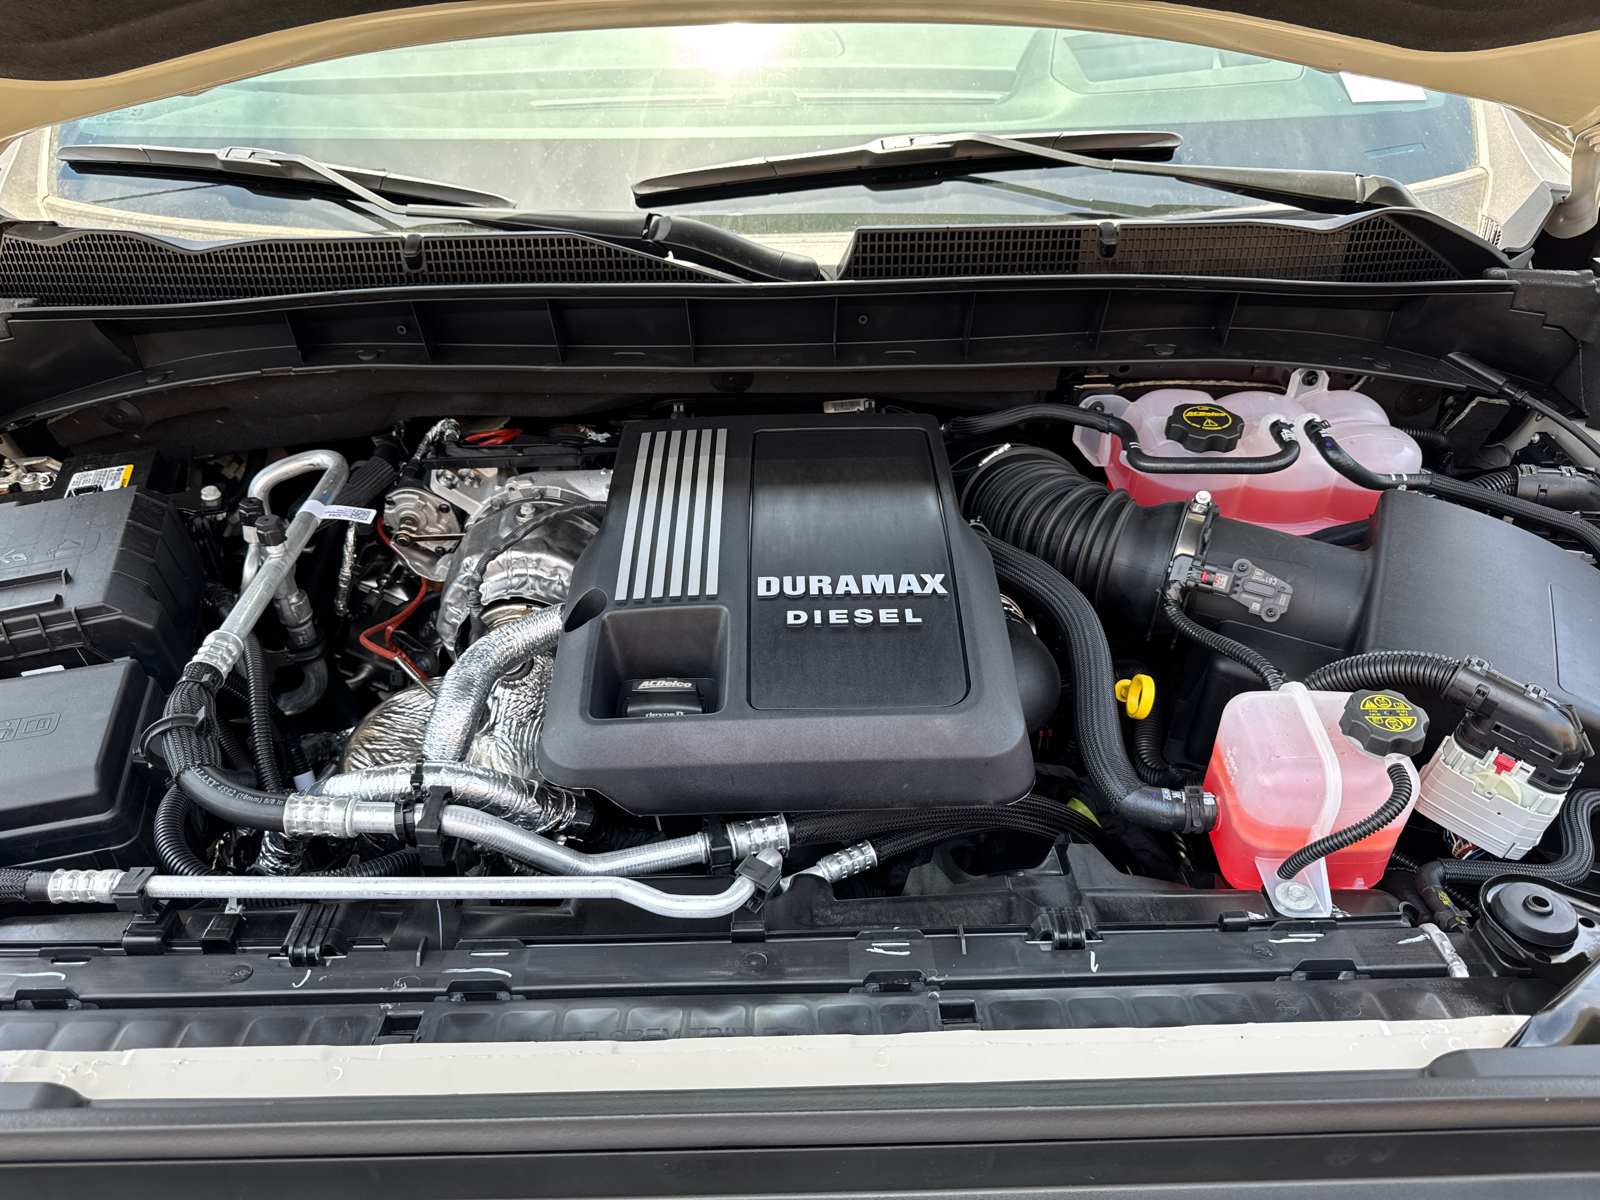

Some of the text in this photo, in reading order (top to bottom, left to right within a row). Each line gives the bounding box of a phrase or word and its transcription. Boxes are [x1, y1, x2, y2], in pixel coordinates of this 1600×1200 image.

[757, 574, 949, 598] DURAMAX
[786, 608, 923, 627] DIESEL
[637, 680, 692, 689] ACDelco
[217, 783, 237, 797] 4882
